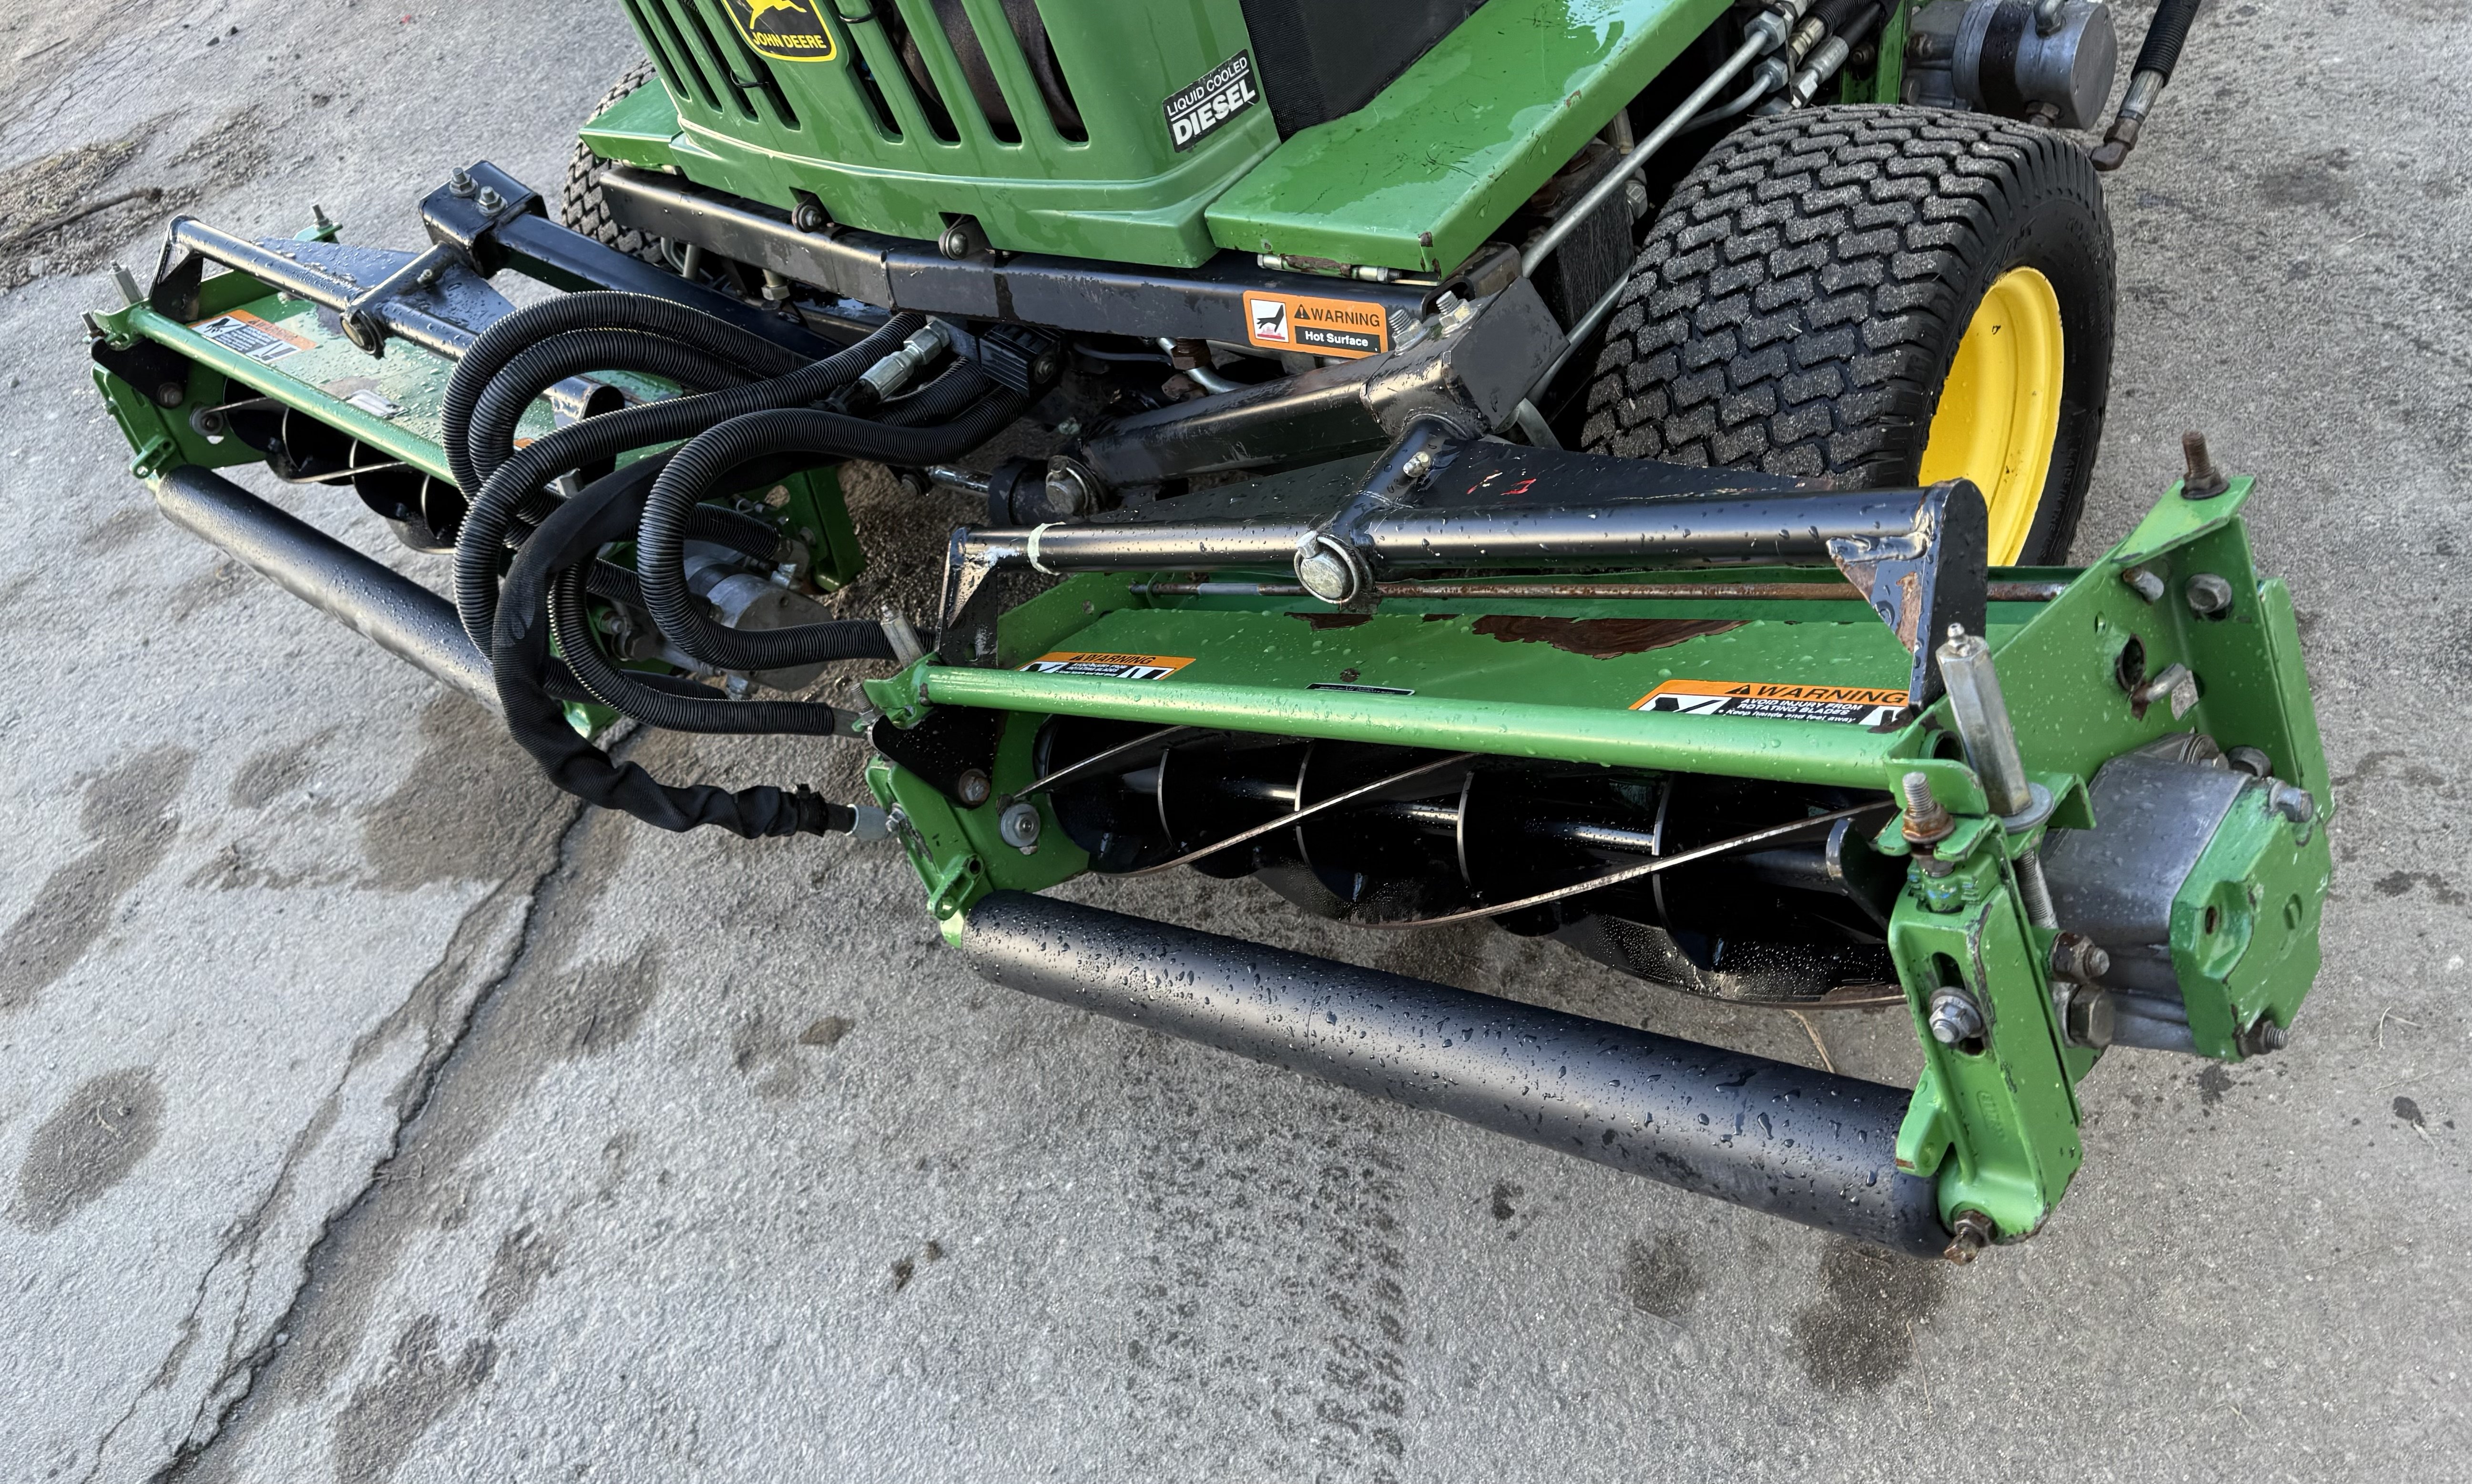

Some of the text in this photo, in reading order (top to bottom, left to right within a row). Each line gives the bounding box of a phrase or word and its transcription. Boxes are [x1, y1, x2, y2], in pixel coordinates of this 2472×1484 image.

[752, 32, 827, 48] JOHN DEERE
[1167, 57, 1247, 116] LIQUID COOLED
[1172, 79, 1256, 145] DIESEL
[1311, 308, 1380, 327] WARNING
[1305, 331, 1369, 347] Hot Surface
[1083, 654, 1156, 664] WARNING
[1757, 685, 1909, 704] WARNING
[1737, 703, 1850, 715] ROTATING BLADES
